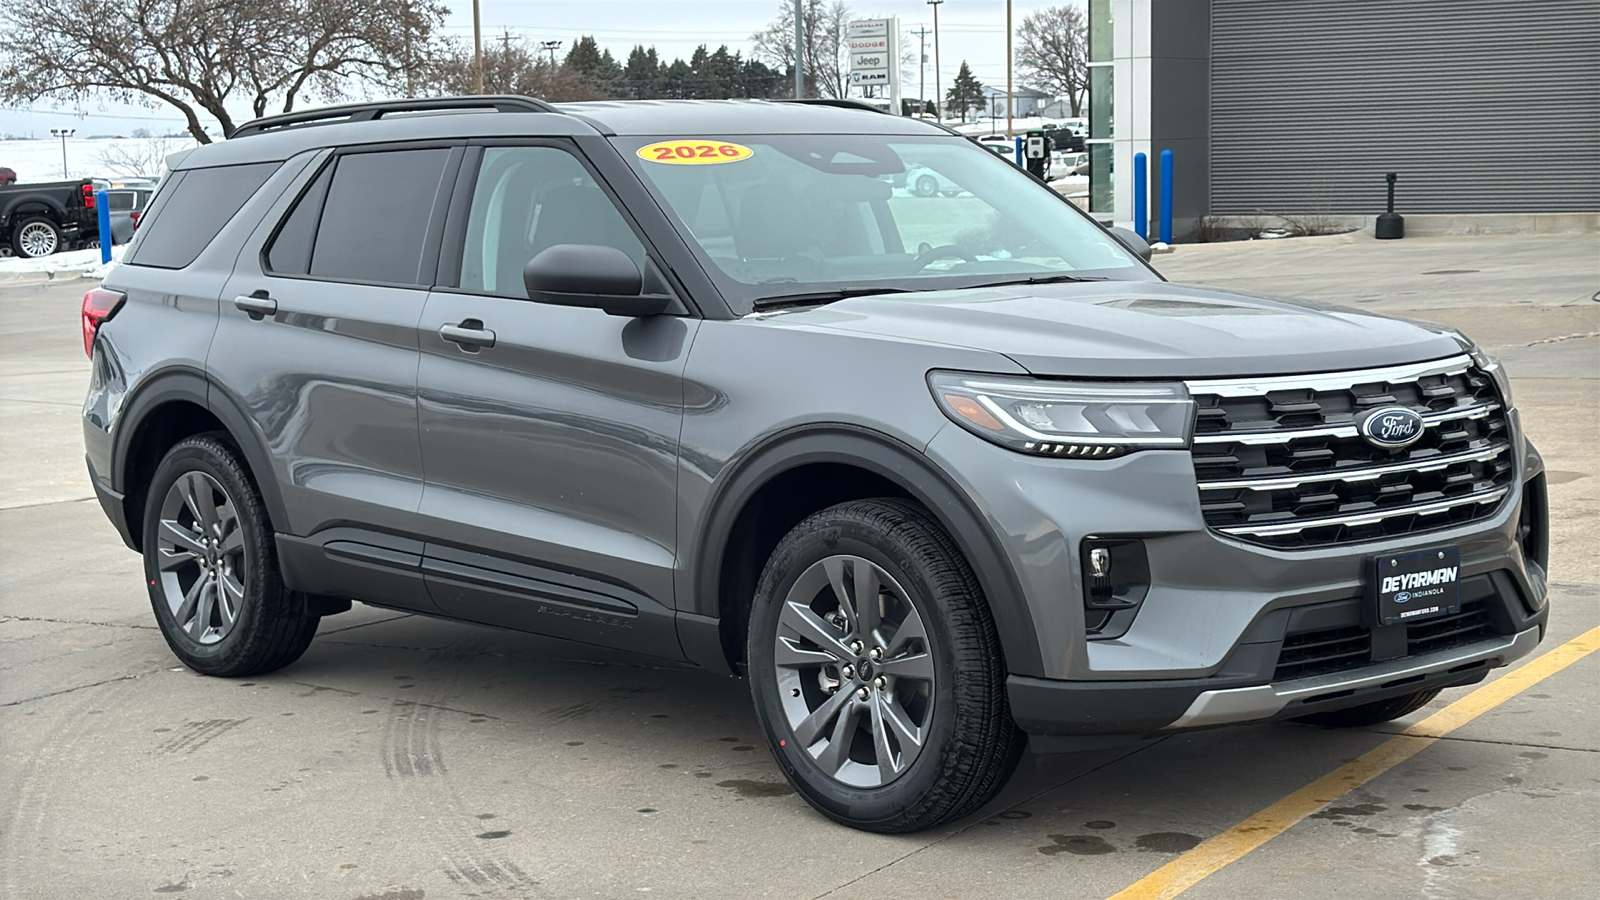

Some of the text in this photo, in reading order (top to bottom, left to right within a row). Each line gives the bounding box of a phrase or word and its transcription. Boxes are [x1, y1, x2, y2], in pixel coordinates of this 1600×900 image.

[857, 56, 880, 66] Jeep
[653, 145, 740, 160] 2026
[1382, 415, 1415, 438] Ford
[1381, 566, 1458, 594] DEYARMAN
[1412, 587, 1444, 598] INDIANOLA
